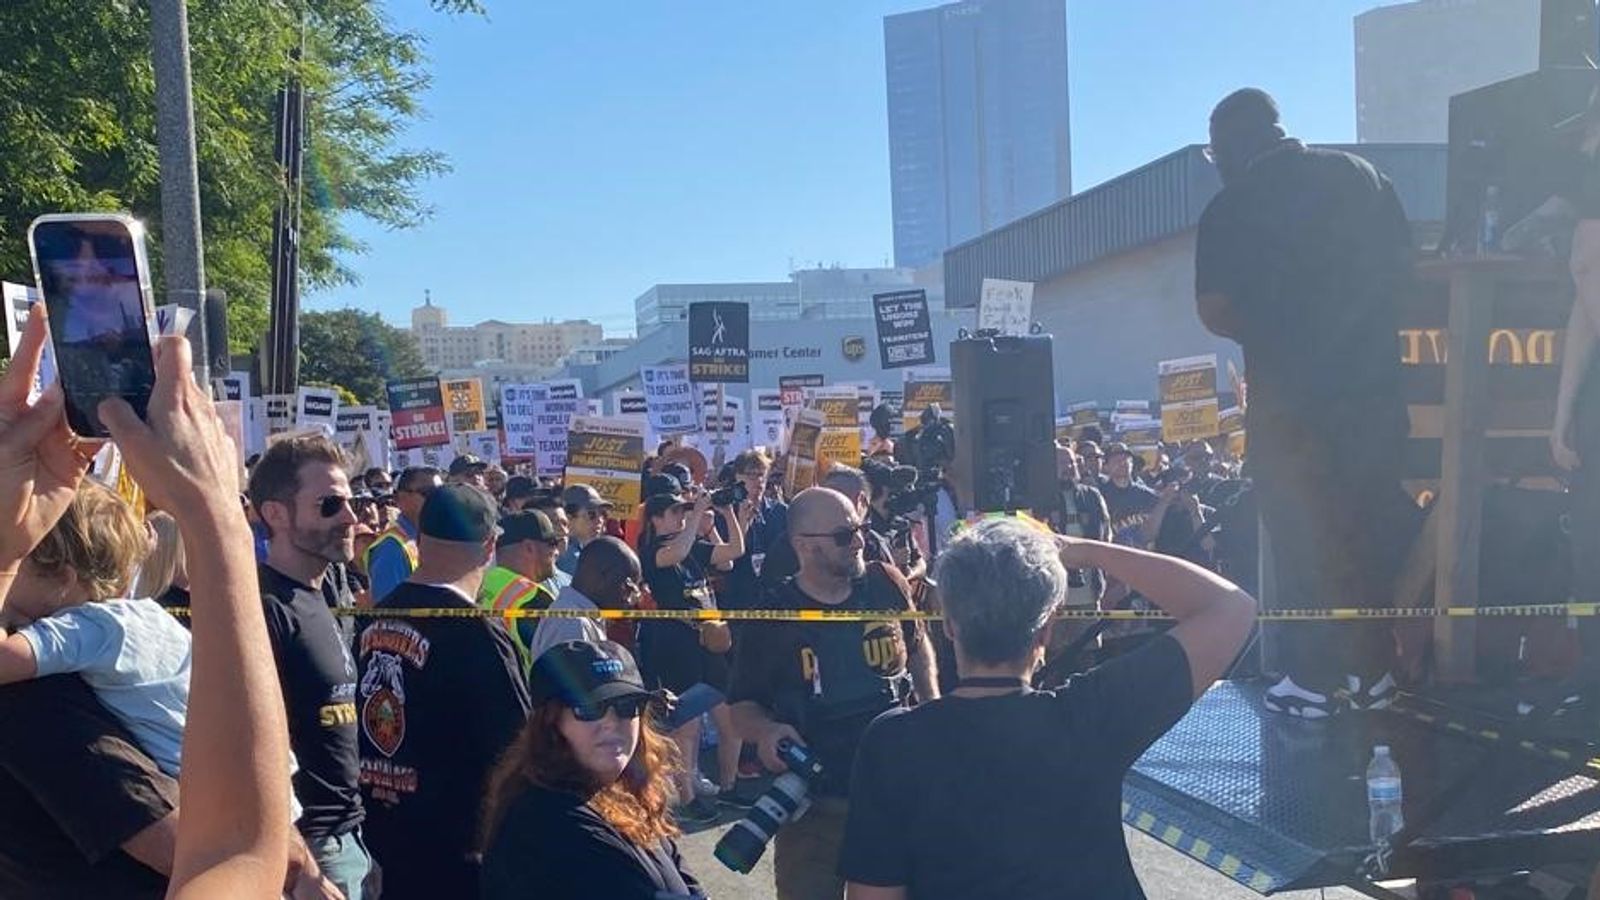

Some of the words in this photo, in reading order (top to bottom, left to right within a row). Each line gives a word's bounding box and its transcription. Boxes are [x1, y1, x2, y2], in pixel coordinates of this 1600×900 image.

[748, 349, 778, 358] omer
[783, 347, 821, 358] Center
[396, 421, 445, 439] STRIKE!
[585, 437, 627, 451] JUST
[822, 435, 848, 446] JUST
